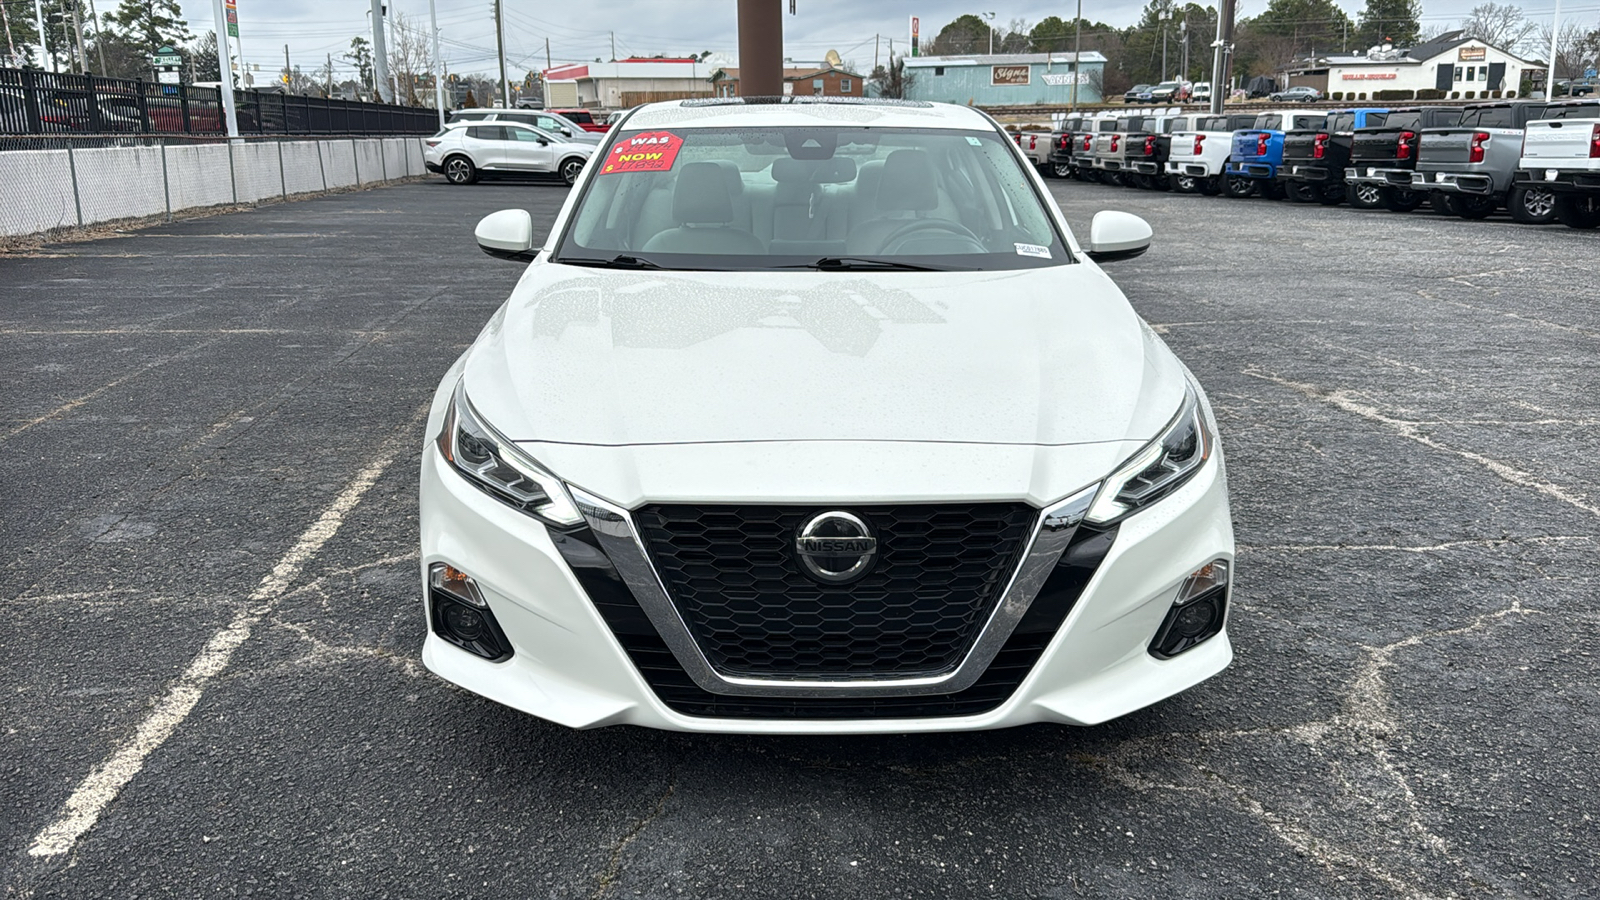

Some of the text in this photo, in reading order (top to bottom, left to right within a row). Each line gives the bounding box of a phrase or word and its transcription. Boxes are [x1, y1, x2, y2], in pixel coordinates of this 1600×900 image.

[994, 68, 1028, 80] Signs
[631, 136, 669, 146] WAS
[618, 152, 663, 162] NOW
[805, 541, 868, 551] NISSAN
